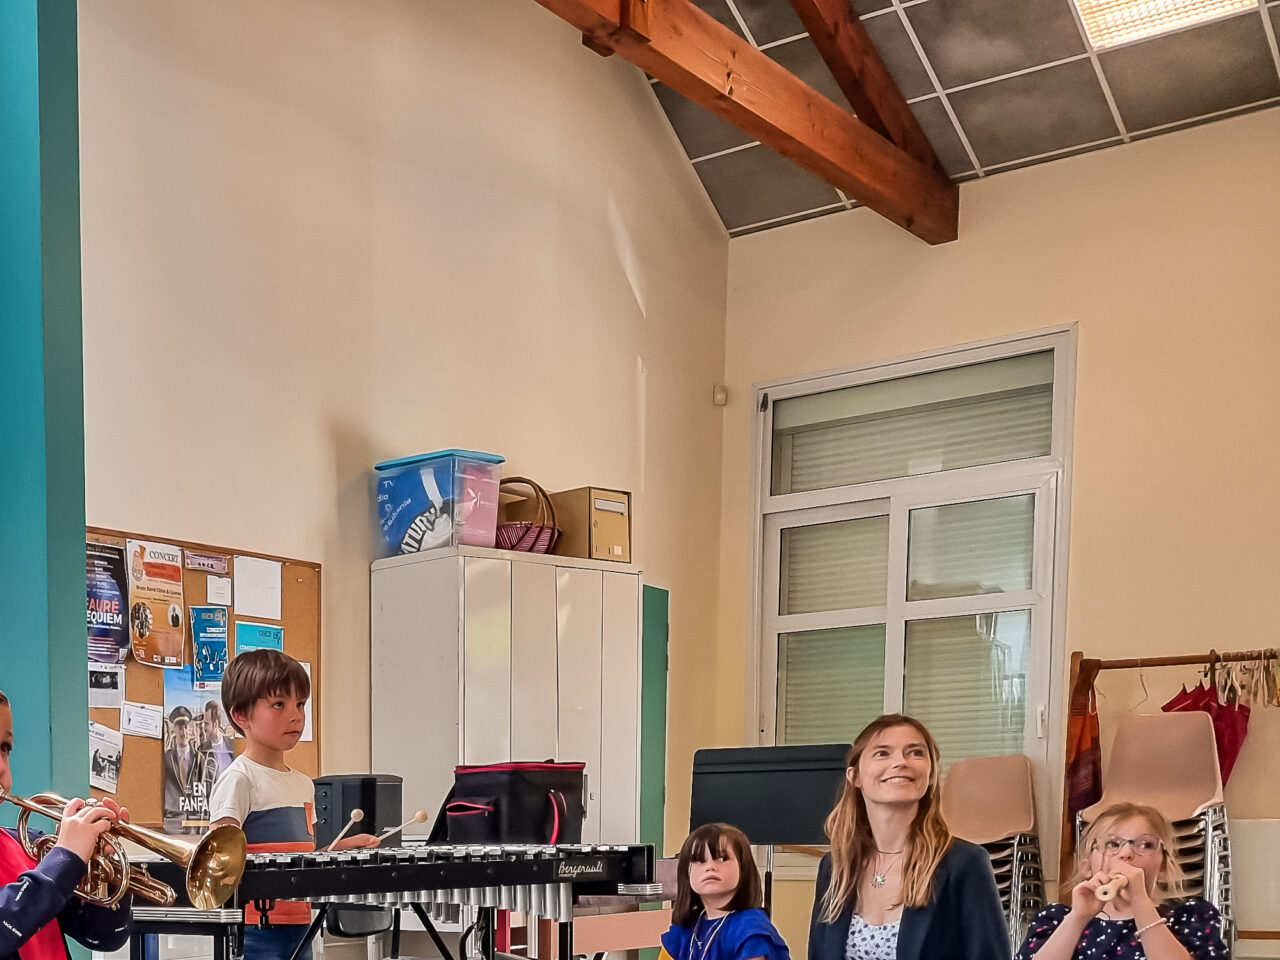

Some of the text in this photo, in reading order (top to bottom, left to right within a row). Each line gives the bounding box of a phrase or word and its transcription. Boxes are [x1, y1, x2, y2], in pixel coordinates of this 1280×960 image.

[149, 550, 179, 564] CONCERT
[193, 781, 207, 796] EN
[179, 796, 210, 812] FANFA
[558, 861, 603, 877] Bergerault
